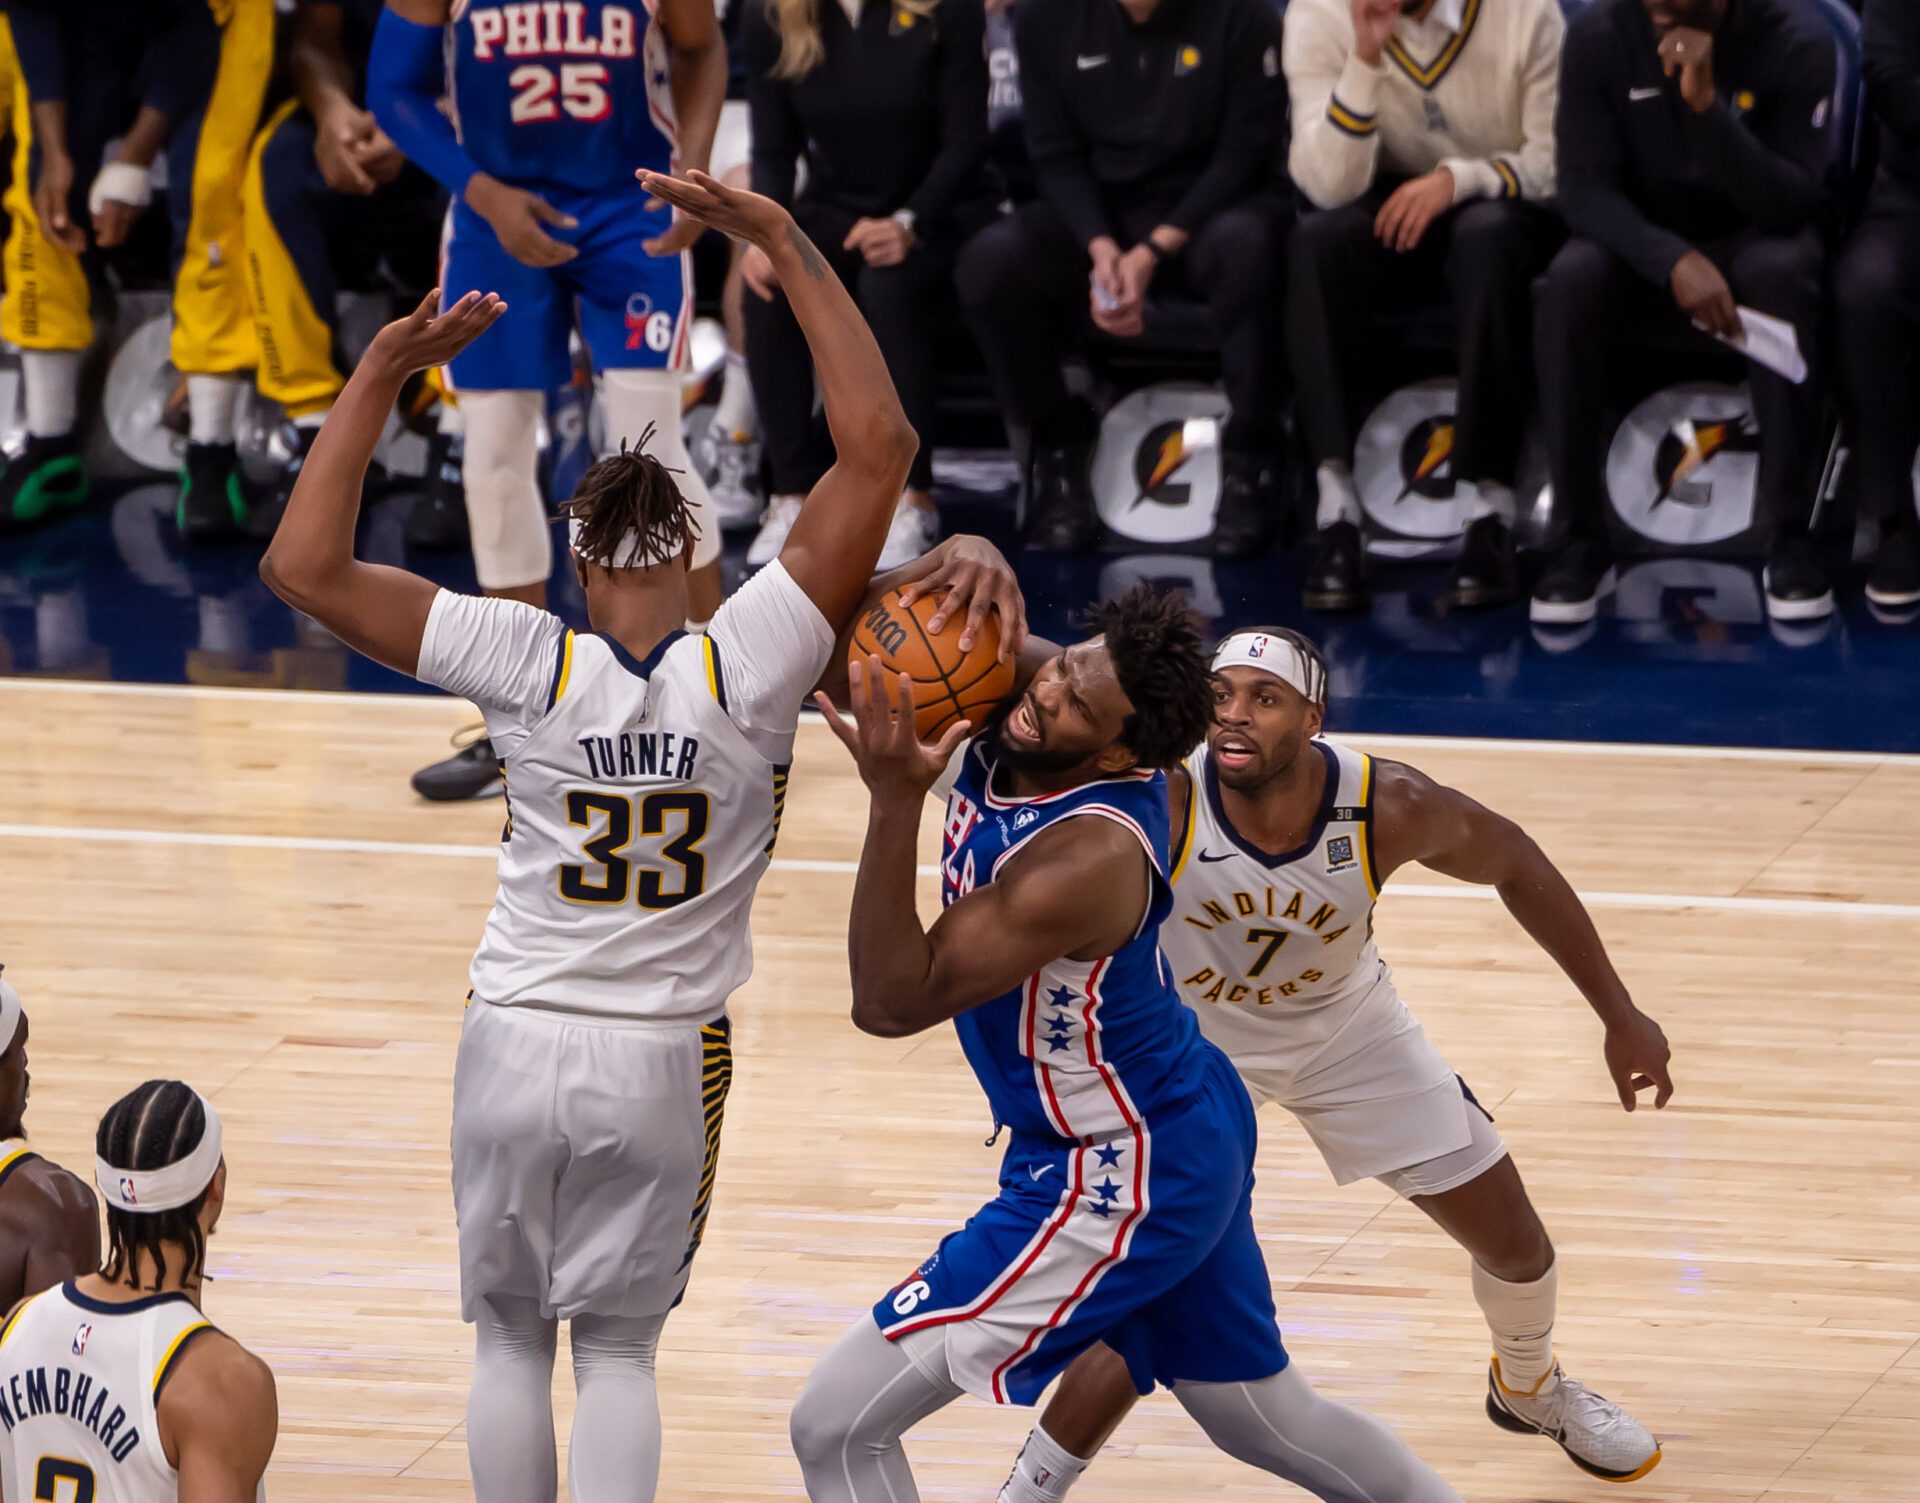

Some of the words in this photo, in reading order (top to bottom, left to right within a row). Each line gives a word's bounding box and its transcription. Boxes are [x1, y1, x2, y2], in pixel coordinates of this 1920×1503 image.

[470, 2, 635, 62] PHILA
[509, 64, 613, 126] 25
[624, 310, 672, 352] 76
[577, 732, 699, 780] TURNER
[1336, 808, 1353, 820] 30
[558, 790, 712, 912] 33
[1184, 886, 1352, 945] INDIANA
[1246, 928, 1291, 978] 7
[1183, 967, 1325, 1005] PACERS
[0, 1367, 140, 1464] NEMBHARD
